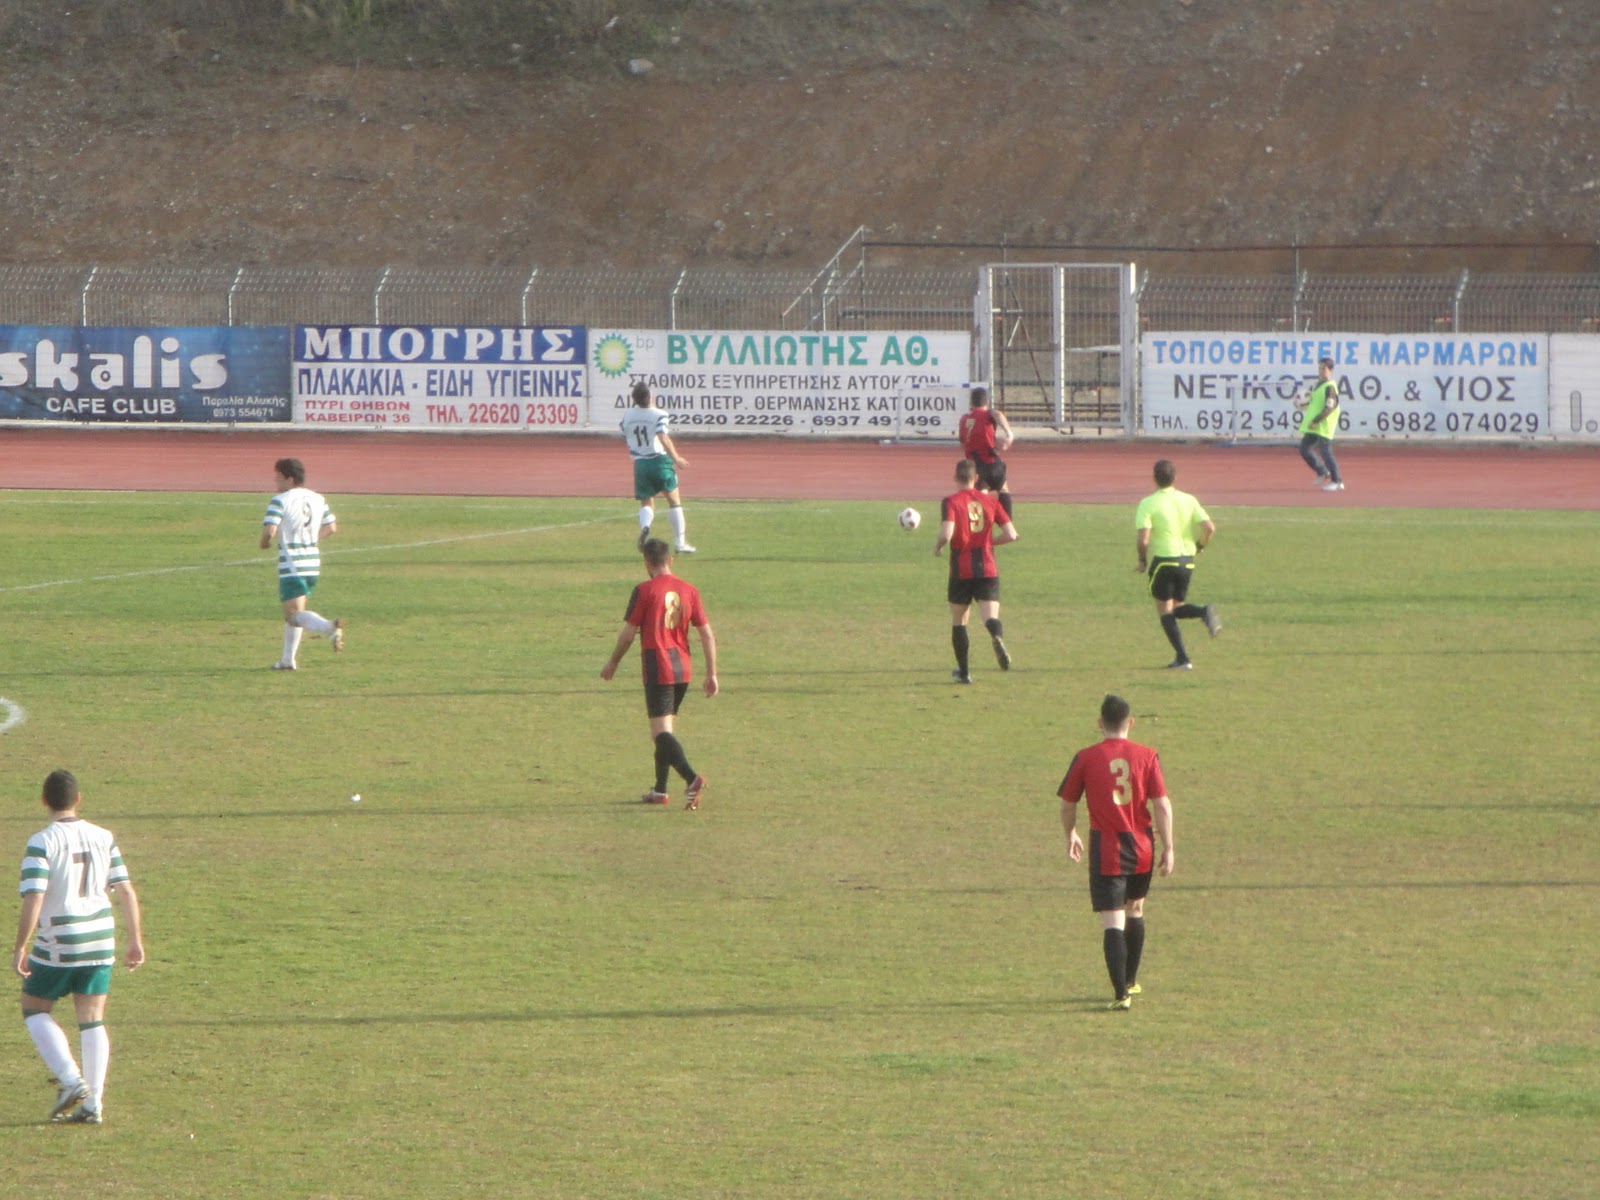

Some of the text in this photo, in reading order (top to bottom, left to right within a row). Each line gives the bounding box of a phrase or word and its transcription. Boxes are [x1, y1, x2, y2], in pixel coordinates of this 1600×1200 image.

[303, 327, 575, 361] ΜΠΟΓΡΗΣ
[636, 335, 655, 349] bp
[667, 334, 939, 366] ΒΥΛΛΙΩΤΗΣ ΑΘ.
[1152, 340, 1537, 366] ΤΟΠΟΘΕΤΗΣΕΙΣ ΜΑΡΜΑΡΩΝ
[298, 368, 405, 396] ΠΛΑΚΑΚΙΑ
[426, 369, 473, 397] ΕΙΔΗ
[486, 369, 583, 397] ΥΓΙΕΙΝΗΣ
[712, 374, 841, 390] ΕΞΥΠΗΡΕΤΗΣΗΣ
[1403, 380, 1422, 401] &
[1434, 375, 1516, 401] ΥΙΟΣ
[46, 397, 177, 415] CAFE CLUB
[305, 400, 411, 411] ΠΥΡΙ ΘΗΒΩΝ
[426, 402, 578, 425] ΤΗΛ. 22620 23309
[701, 396, 749, 410] ΠΕΤΡ.
[754, 396, 861, 411] ΘΕΡΜΑΝΣΗΣ
[392, 413, 411, 423] 36
[734, 414, 794, 426] 22226
[812, 415, 861, 427] 6937
[905, 415, 941, 427] 496
[1151, 415, 1188, 430] ΤΗΛ.
[1197, 410, 1253, 430] 6972
[1376, 411, 1437, 432] 6982
[1446, 412, 1539, 433] 074029
[633, 424, 649, 447] 11
[302, 502, 312, 527] 9
[967, 501, 985, 533] 9
[664, 591, 680, 630] 8
[1109, 758, 1132, 805] 3
[72, 851, 92, 898] 7
